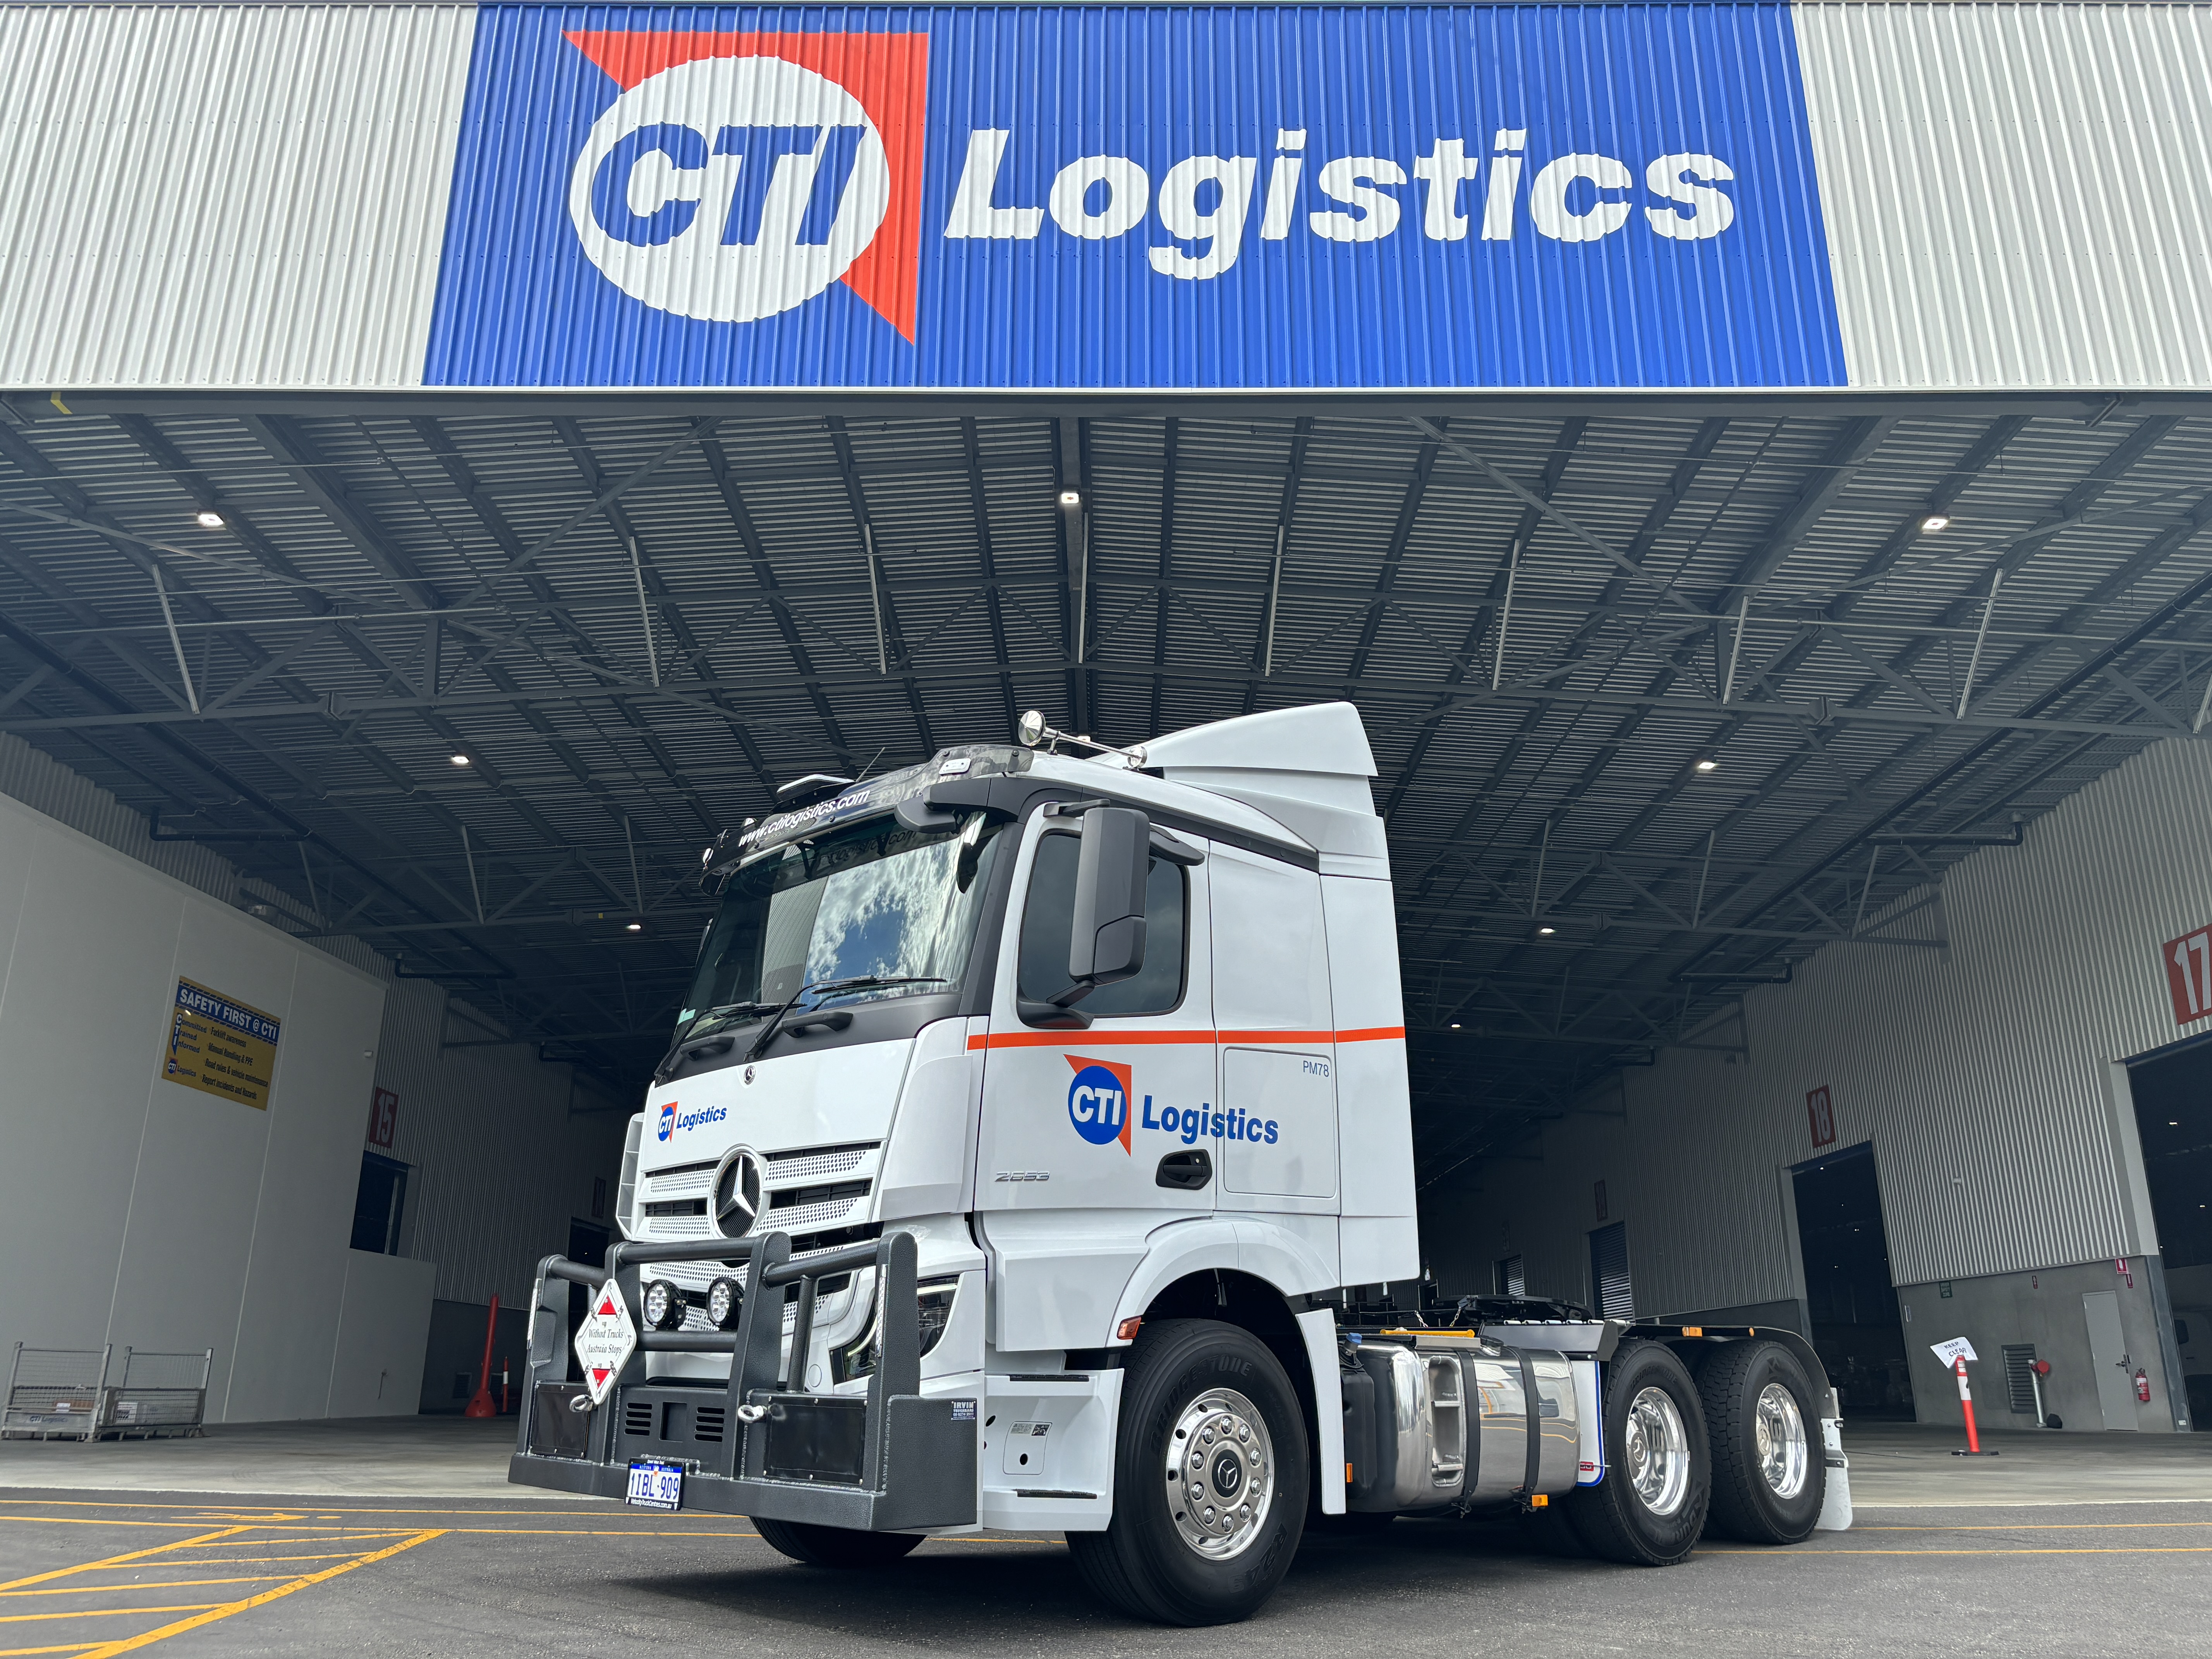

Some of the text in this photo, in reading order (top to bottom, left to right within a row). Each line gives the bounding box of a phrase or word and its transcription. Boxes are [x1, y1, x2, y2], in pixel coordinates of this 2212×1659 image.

[591, 121, 1735, 280] CTI Logistics
[738, 790, 871, 847] www.ctilogistics.com
[2174, 932, 2211, 1014] 17
[180, 989, 277, 1040] SAFETY FIRST @ CTI
[173, 1036, 200, 1053] Informed
[175, 1025, 197, 1041] Trained
[168, 1062, 196, 1077] CTI Logistics
[1303, 1060, 1329, 1077] PM78
[376, 1093, 395, 1143] 15
[659, 1106, 727, 1133] CTI Logistics
[1072, 1084, 1279, 1144] CTI Logistics
[1811, 1091, 1831, 1142] 18
[995, 1171, 1050, 1182] 2653
[608, 1329, 623, 1338] Trucks
[587, 1344, 622, 1356] Austraia Stops
[1949, 1348, 1967, 1357] CLEAR
[1630, 1365, 1678, 1393] BRIDGEONE
[1150, 1354, 1252, 1456] BRIDGESTONE
